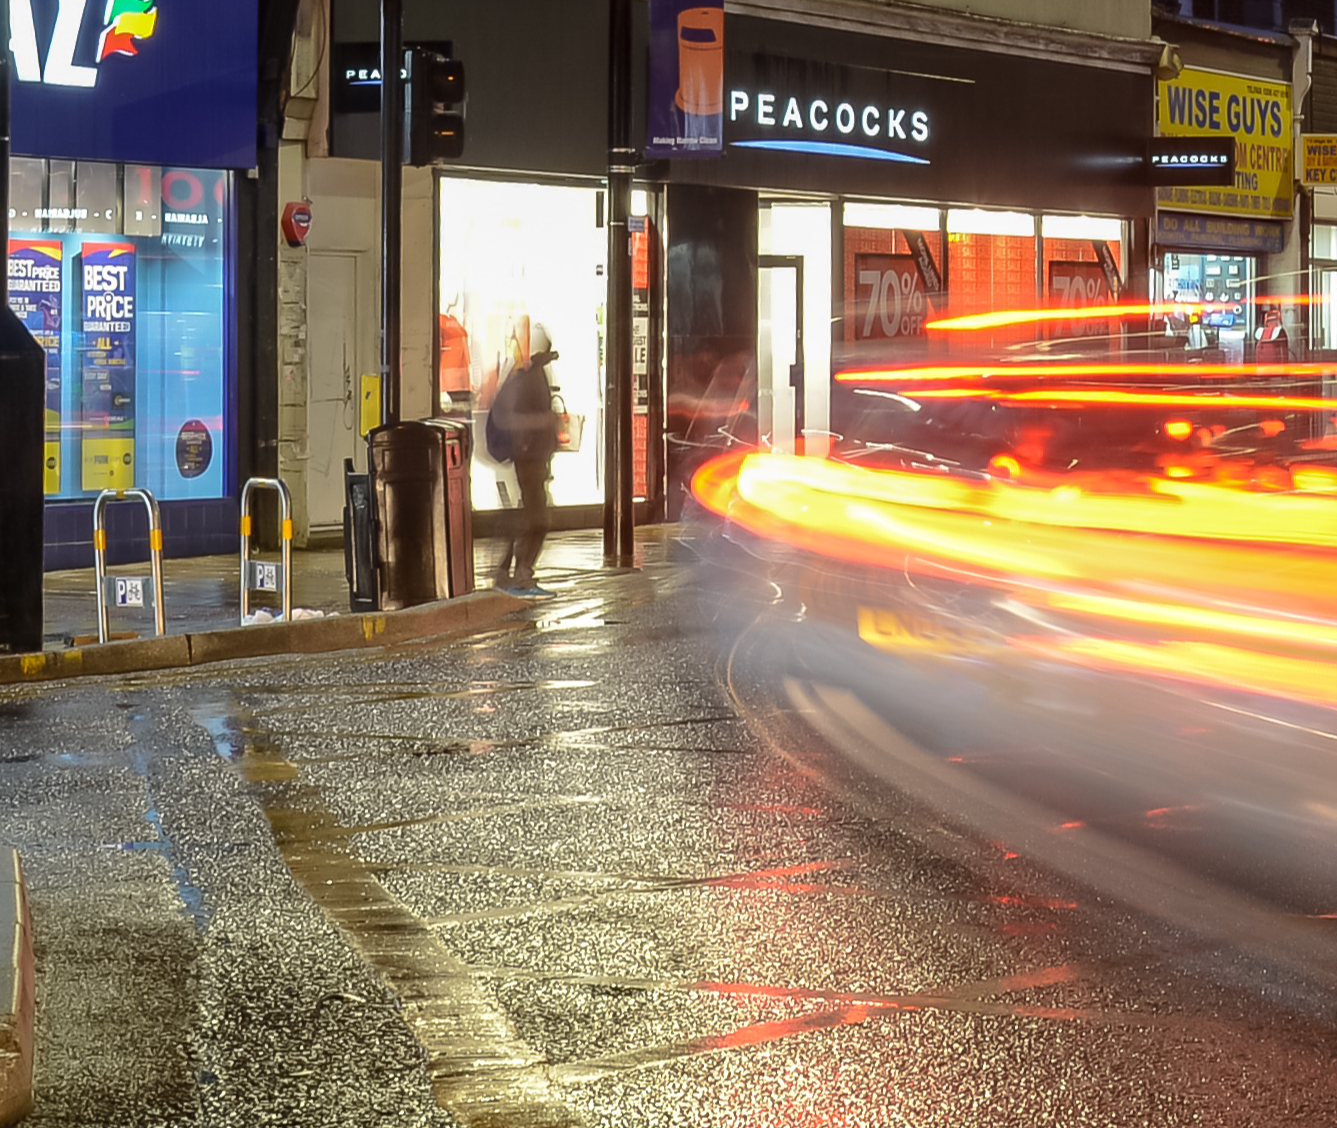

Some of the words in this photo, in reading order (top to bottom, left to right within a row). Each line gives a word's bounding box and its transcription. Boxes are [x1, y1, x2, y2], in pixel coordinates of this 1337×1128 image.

[730, 90, 930, 142] PEACOCKS
[1167, 84, 1221, 131] WISE
[1226, 94, 1282, 138] GUYS
[652, 136, 675, 146] Making
[699, 136, 718, 145] Clean
[1306, 145, 1337, 156] WISE
[1151, 155, 1228, 164] PEACOCKS
[1250, 142, 1289, 174] CENTRE
[1306, 168, 1327, 181] KEY
[1163, 217, 1178, 231] DO
[1184, 218, 1200, 232] ALL
[1206, 220, 1250, 235] BUILDING
[8, 259, 35, 278] BEST
[84, 265, 128, 291] BEST
[860, 270, 923, 337] 70%
[900, 316, 923, 336] OFF
[97, 337, 113, 349] ALL
